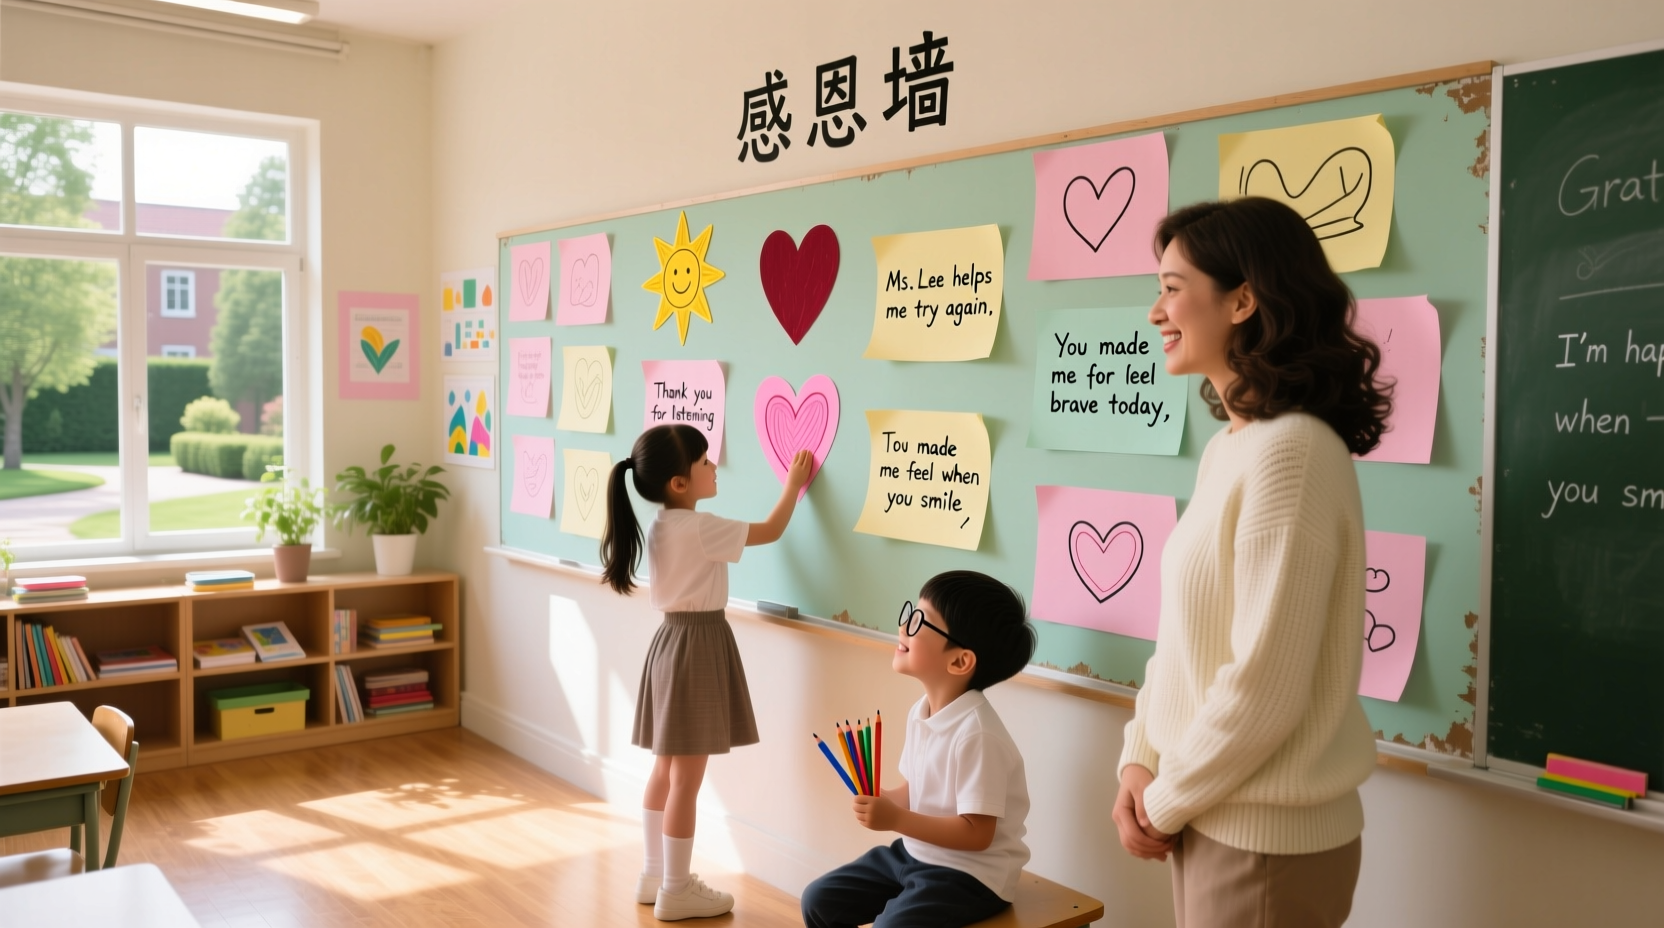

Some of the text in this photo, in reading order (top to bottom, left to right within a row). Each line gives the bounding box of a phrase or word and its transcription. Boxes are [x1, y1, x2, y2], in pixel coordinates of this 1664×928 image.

[736, 30, 954, 163] 感恩墙
[886, 263, 992, 293] Ms. Lee helps
[886, 298, 993, 327] me try again,
[1055, 331, 1149, 358] You made
[1556, 332, 1607, 368] I'm
[1052, 371, 1077, 384] me
[1087, 363, 1115, 390] for
[654, 381, 712, 407] Thank you
[651, 404, 667, 422] for
[1051, 391, 1170, 427] brave today,
[1556, 398, 1630, 434] when
[882, 431, 957, 456] Tou made
[880, 461, 980, 485] me feel when
[884, 492, 913, 513] you
[1541, 480, 1598, 519] you
